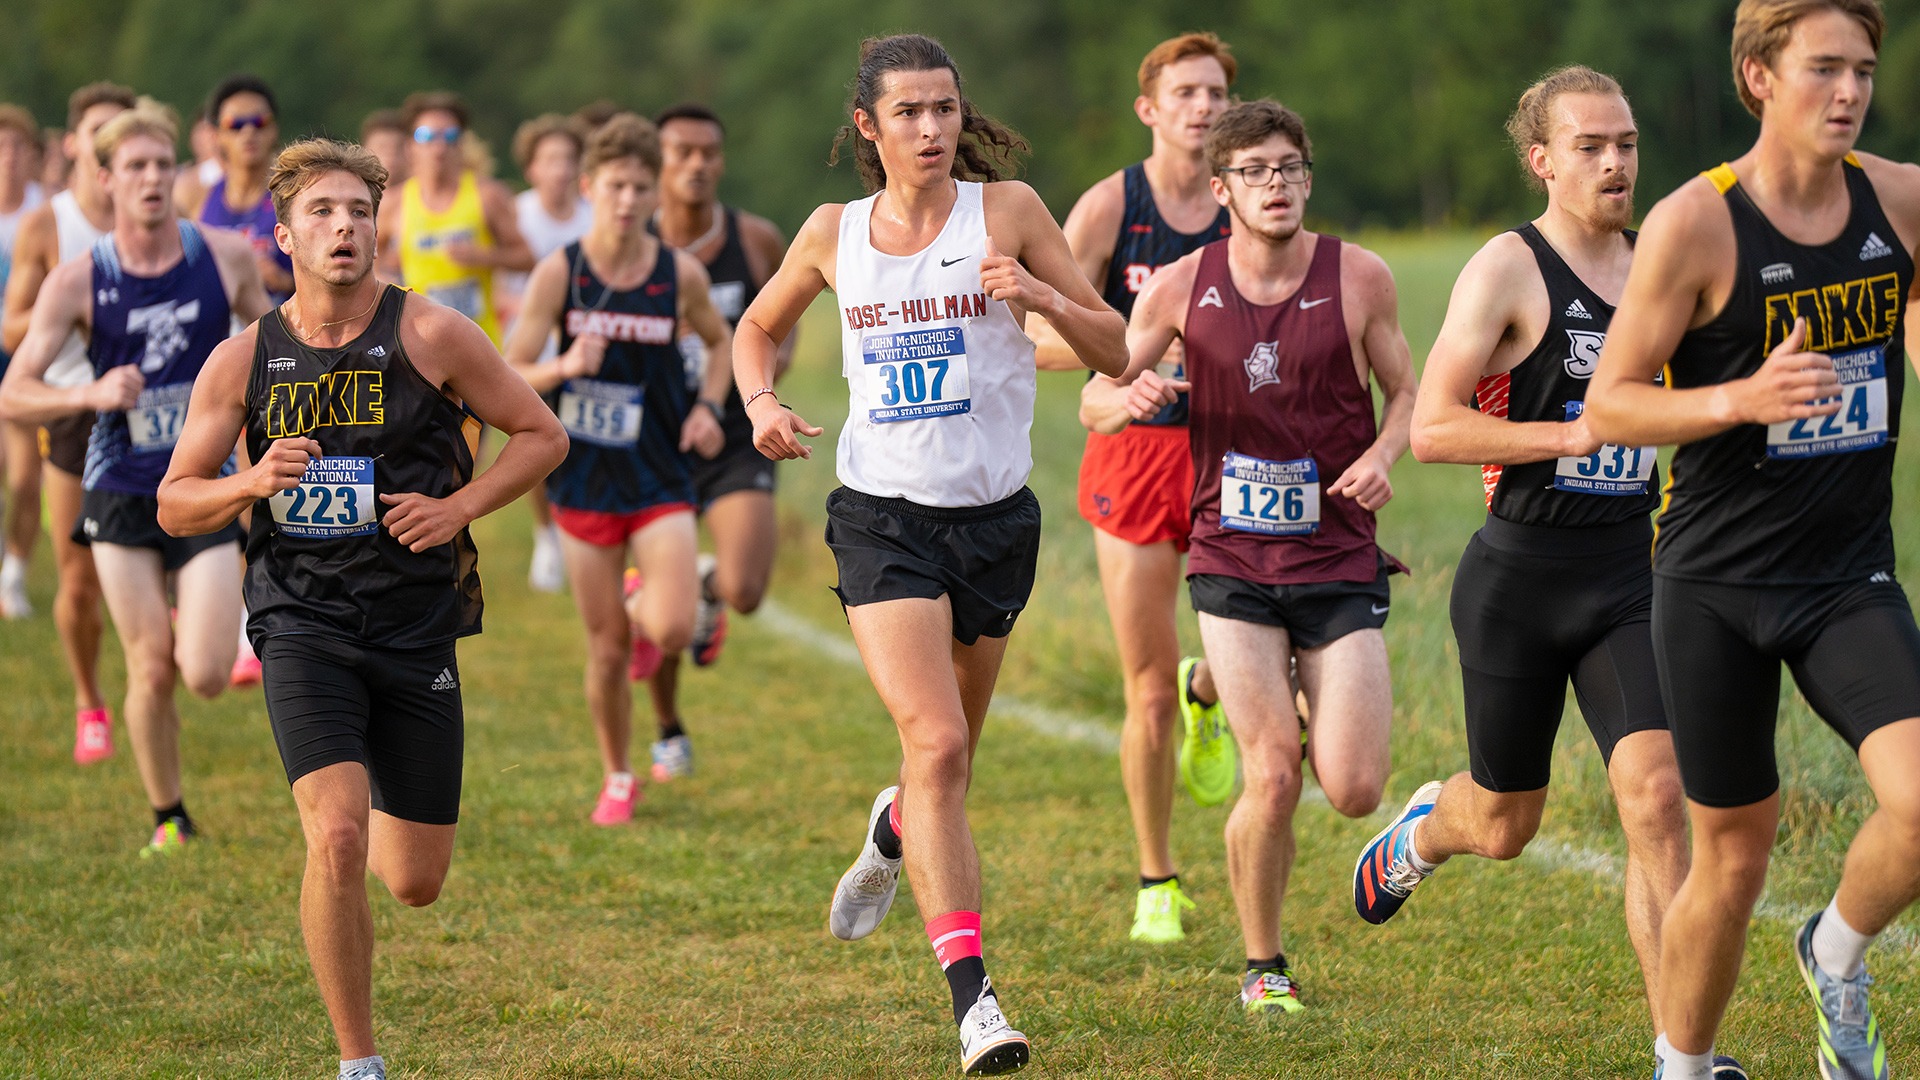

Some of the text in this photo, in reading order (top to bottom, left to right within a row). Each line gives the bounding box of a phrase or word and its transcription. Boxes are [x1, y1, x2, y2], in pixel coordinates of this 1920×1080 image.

[1859, 246, 1893, 262] adidas
[1565, 310, 1593, 320] adidas
[1763, 271, 1899, 358] MKE
[869, 330, 956, 350] JOHN McNICHOLS
[875, 343, 951, 361] INVITATIONAL
[1832, 350, 1877, 370] NICHOLS
[879, 359, 949, 406] 307
[267, 371, 384, 439] MKE
[875, 409, 899, 419] INDIANA
[901, 406, 923, 416] STATE
[924, 402, 964, 414] UNIVERSITY
[144, 406, 187, 438] 37
[1777, 434, 1879, 455] INDIANA STATE UNIVERSITY
[306, 460, 366, 471] McNICHOLS
[1230, 456, 1311, 473] JOHN McNICHOLS
[1235, 468, 1306, 484] INVITATIONAL
[1564, 478, 1643, 491] INDIANA STATE UNIVERSITY
[283, 486, 359, 525] 223
[1239, 484, 1304, 521] 126
[281, 525, 307, 534] INDIANA
[330, 525, 370, 536] UNIVERSITY
[1228, 518, 1253, 528] INDIANA
[1254, 522, 1274, 530] STATE
[431, 682, 457, 690] adidas
